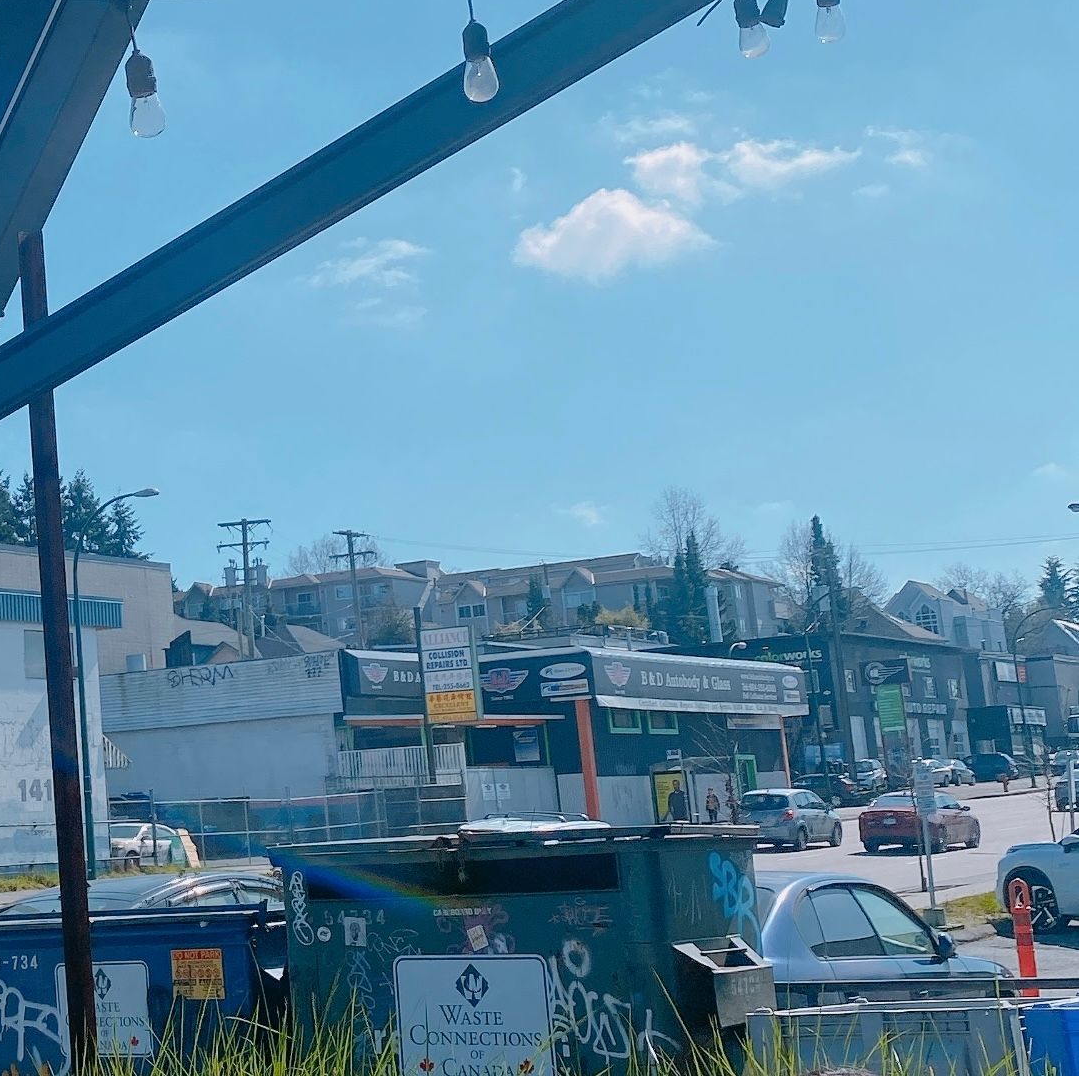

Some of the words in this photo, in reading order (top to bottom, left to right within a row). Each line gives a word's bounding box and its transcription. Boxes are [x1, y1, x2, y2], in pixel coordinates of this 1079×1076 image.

[428, 649, 465, 660] COLLISION
[426, 660, 454, 670] REPAIRS
[665, 673, 701, 692] Autobody
[712, 677, 732, 691] Glass
[184, 951, 199, 960] NOT
[201, 950, 220, 959] PARK
[95, 1001, 121, 1013] ASTE
[439, 1004, 504, 1026] WASTE
[409, 1024, 543, 1047] CONNECTIONS
[470, 1049, 485, 1060] OF
